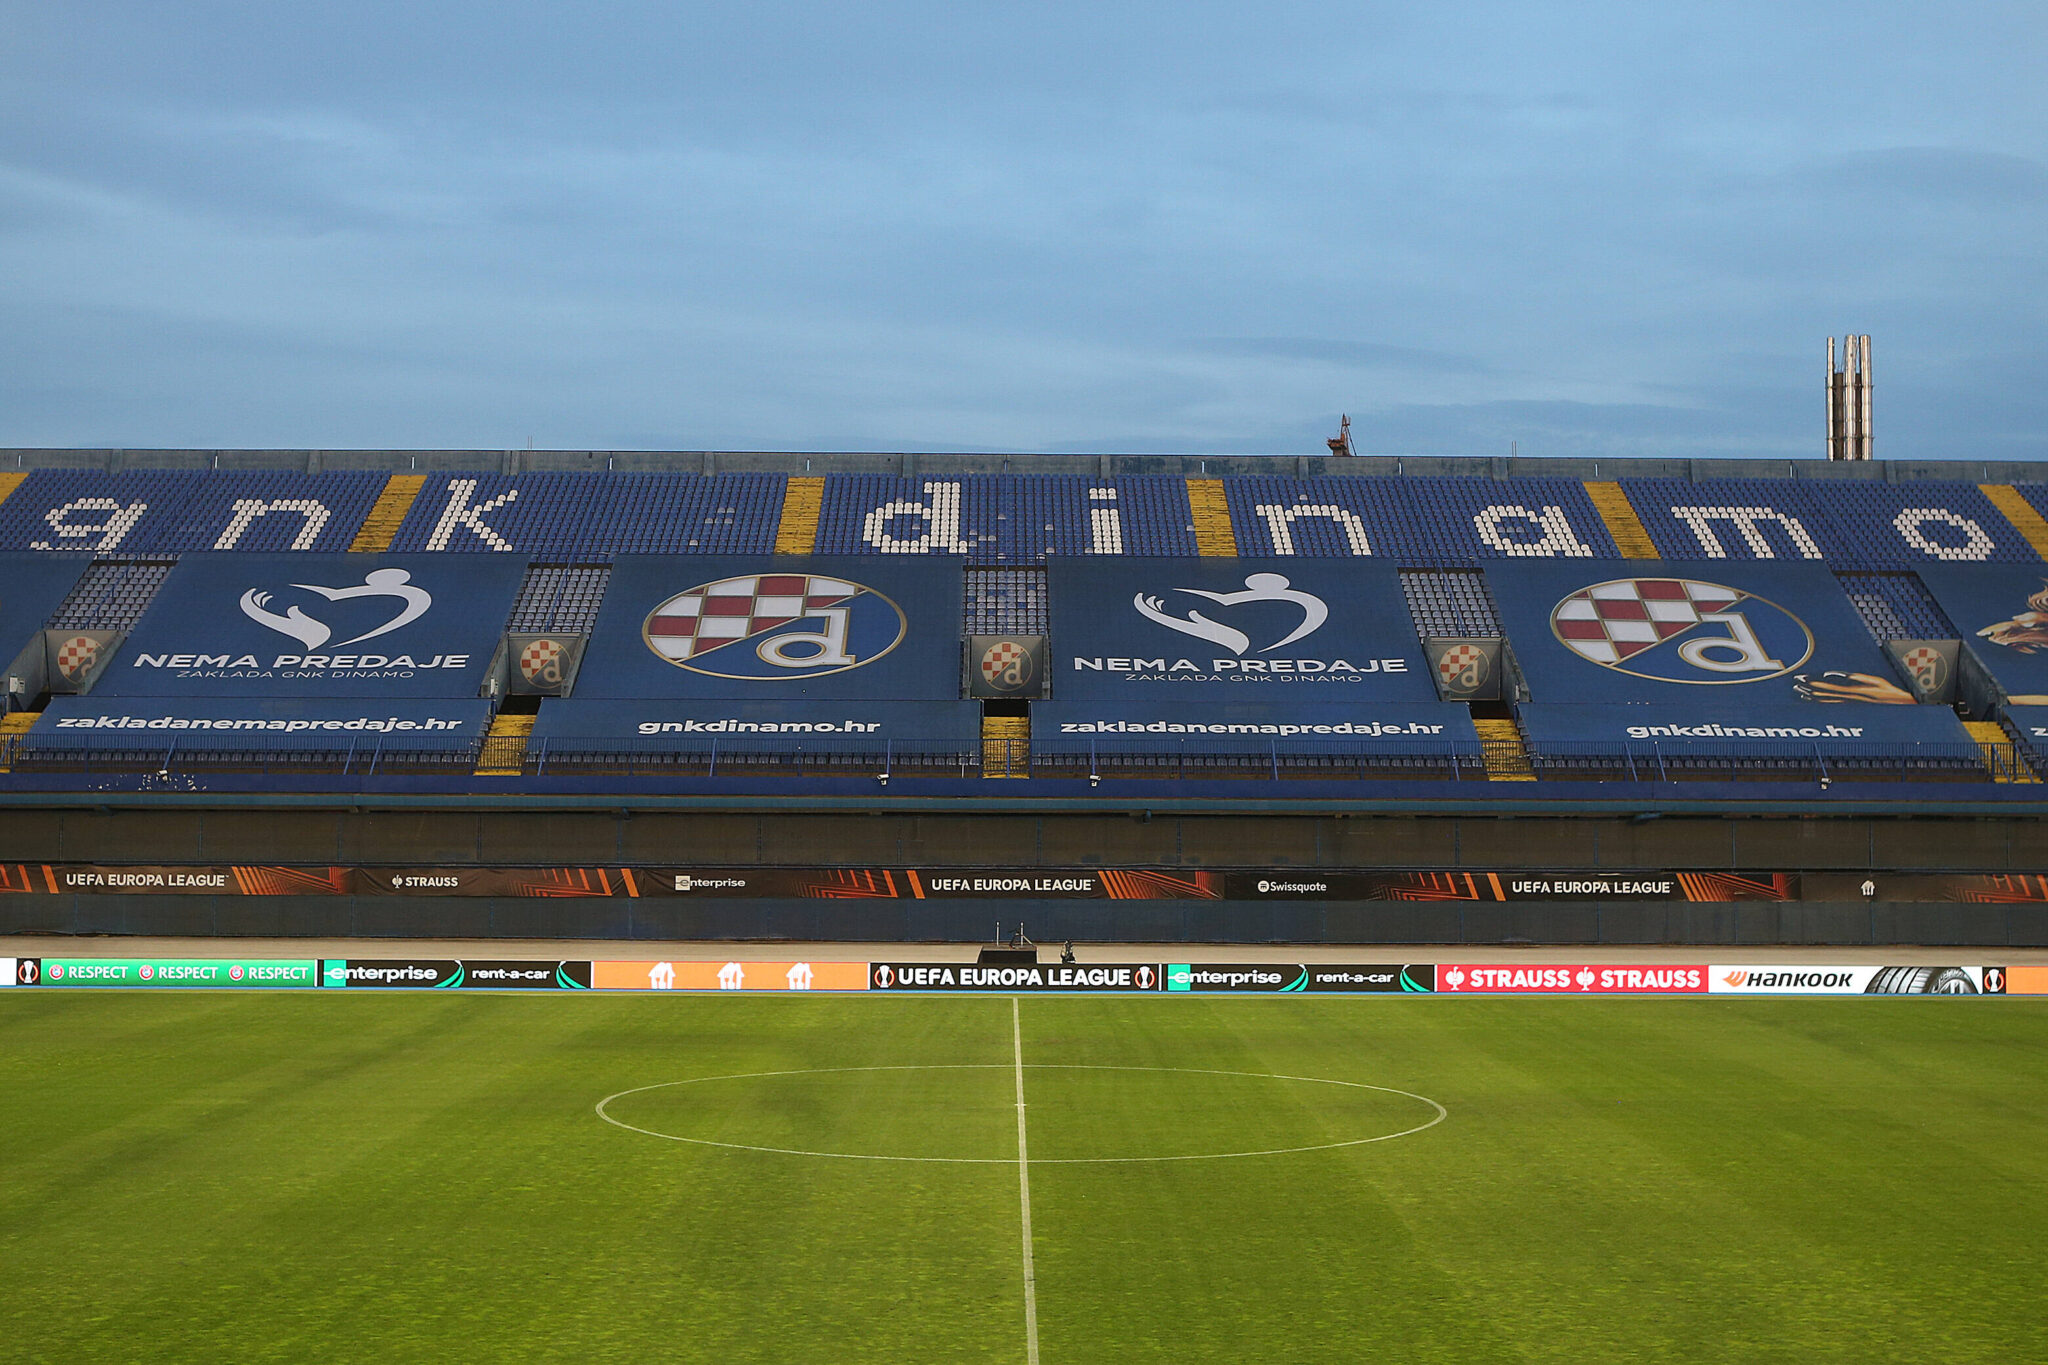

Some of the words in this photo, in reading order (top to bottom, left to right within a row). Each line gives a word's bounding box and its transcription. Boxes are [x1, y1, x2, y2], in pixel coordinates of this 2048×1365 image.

[133, 653, 259, 668] NEMA
[272, 654, 470, 669] PREDAJE
[1074, 657, 1201, 672] NEMA
[1212, 658, 1408, 673] PREDAJE
[176, 670, 273, 678] ZAKLADA
[1125, 673, 1223, 682] ZAKLADA
[1229, 674, 1273, 682] GNK
[1280, 675, 1362, 683] DINAMO
[56, 716, 463, 733] zakladanemapredaje.hr
[638, 719, 881, 735] gnkdinamo.hr
[1060, 720, 1444, 737] zakladanemapredaje.hr
[1626, 723, 1863, 739] gnkdinamo.hr
[66, 873, 105, 886] UEFA
[107, 874, 165, 886] EUROPA
[167, 874, 225, 887] LEAGUE
[405, 876, 459, 887] STRAUSS
[676, 876, 746, 890] enterprise
[931, 878, 971, 891] UEFA
[974, 878, 1032, 891] EUROPA
[1034, 879, 1092, 891] LEAGUE
[1270, 881, 1327, 894] Swissquote
[1512, 881, 1551, 893] UEFA
[1554, 881, 1611, 894] EUROPA
[1614, 881, 1671, 894] LEAGUE
[68, 965, 129, 979] RESPECT
[158, 966, 219, 980] RESPECT
[248, 966, 309, 980] RESPECT
[323, 965, 438, 983] enterprise
[472, 968, 551, 980] rent-a-car
[898, 967, 956, 985] UEFA
[959, 968, 1044, 986] EUROPA
[1047, 968, 1131, 986] LEAGUE
[1167, 969, 1282, 987] enterprise
[1316, 972, 1395, 983] rent-a-car
[1470, 969, 1571, 988] STRAUSS
[1600, 969, 1701, 989] STRAUSS
